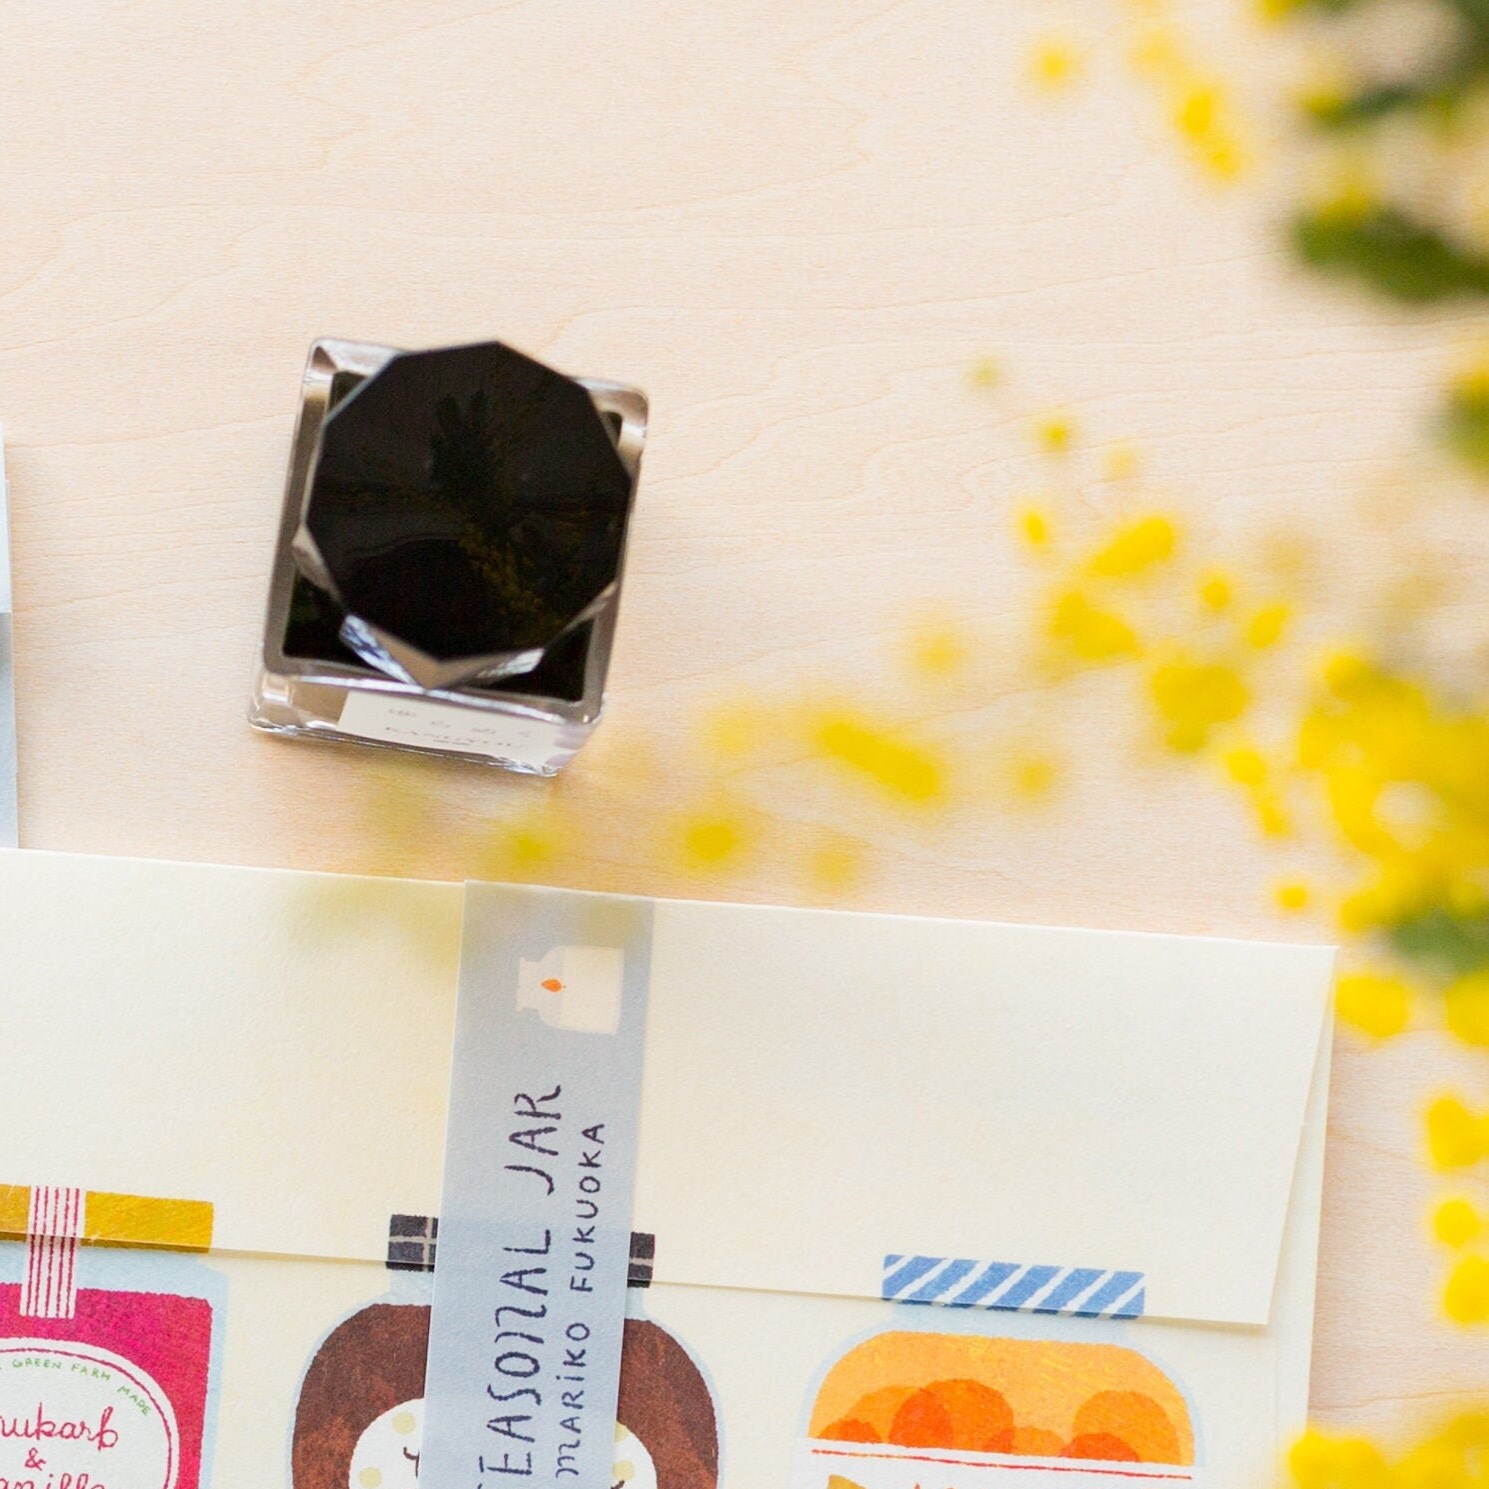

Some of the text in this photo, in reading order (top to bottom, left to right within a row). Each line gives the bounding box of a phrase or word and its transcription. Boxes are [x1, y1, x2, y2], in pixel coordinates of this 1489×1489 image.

[504, 1084, 562, 1196] JAR
[569, 1123, 605, 1293] FUKUOKA
[11, 1357, 61, 1369] GREEN
[71, 1363, 111, 1381] FARM
[117, 1385, 152, 1416] MADE
[24, 1447, 47, 1471] &
